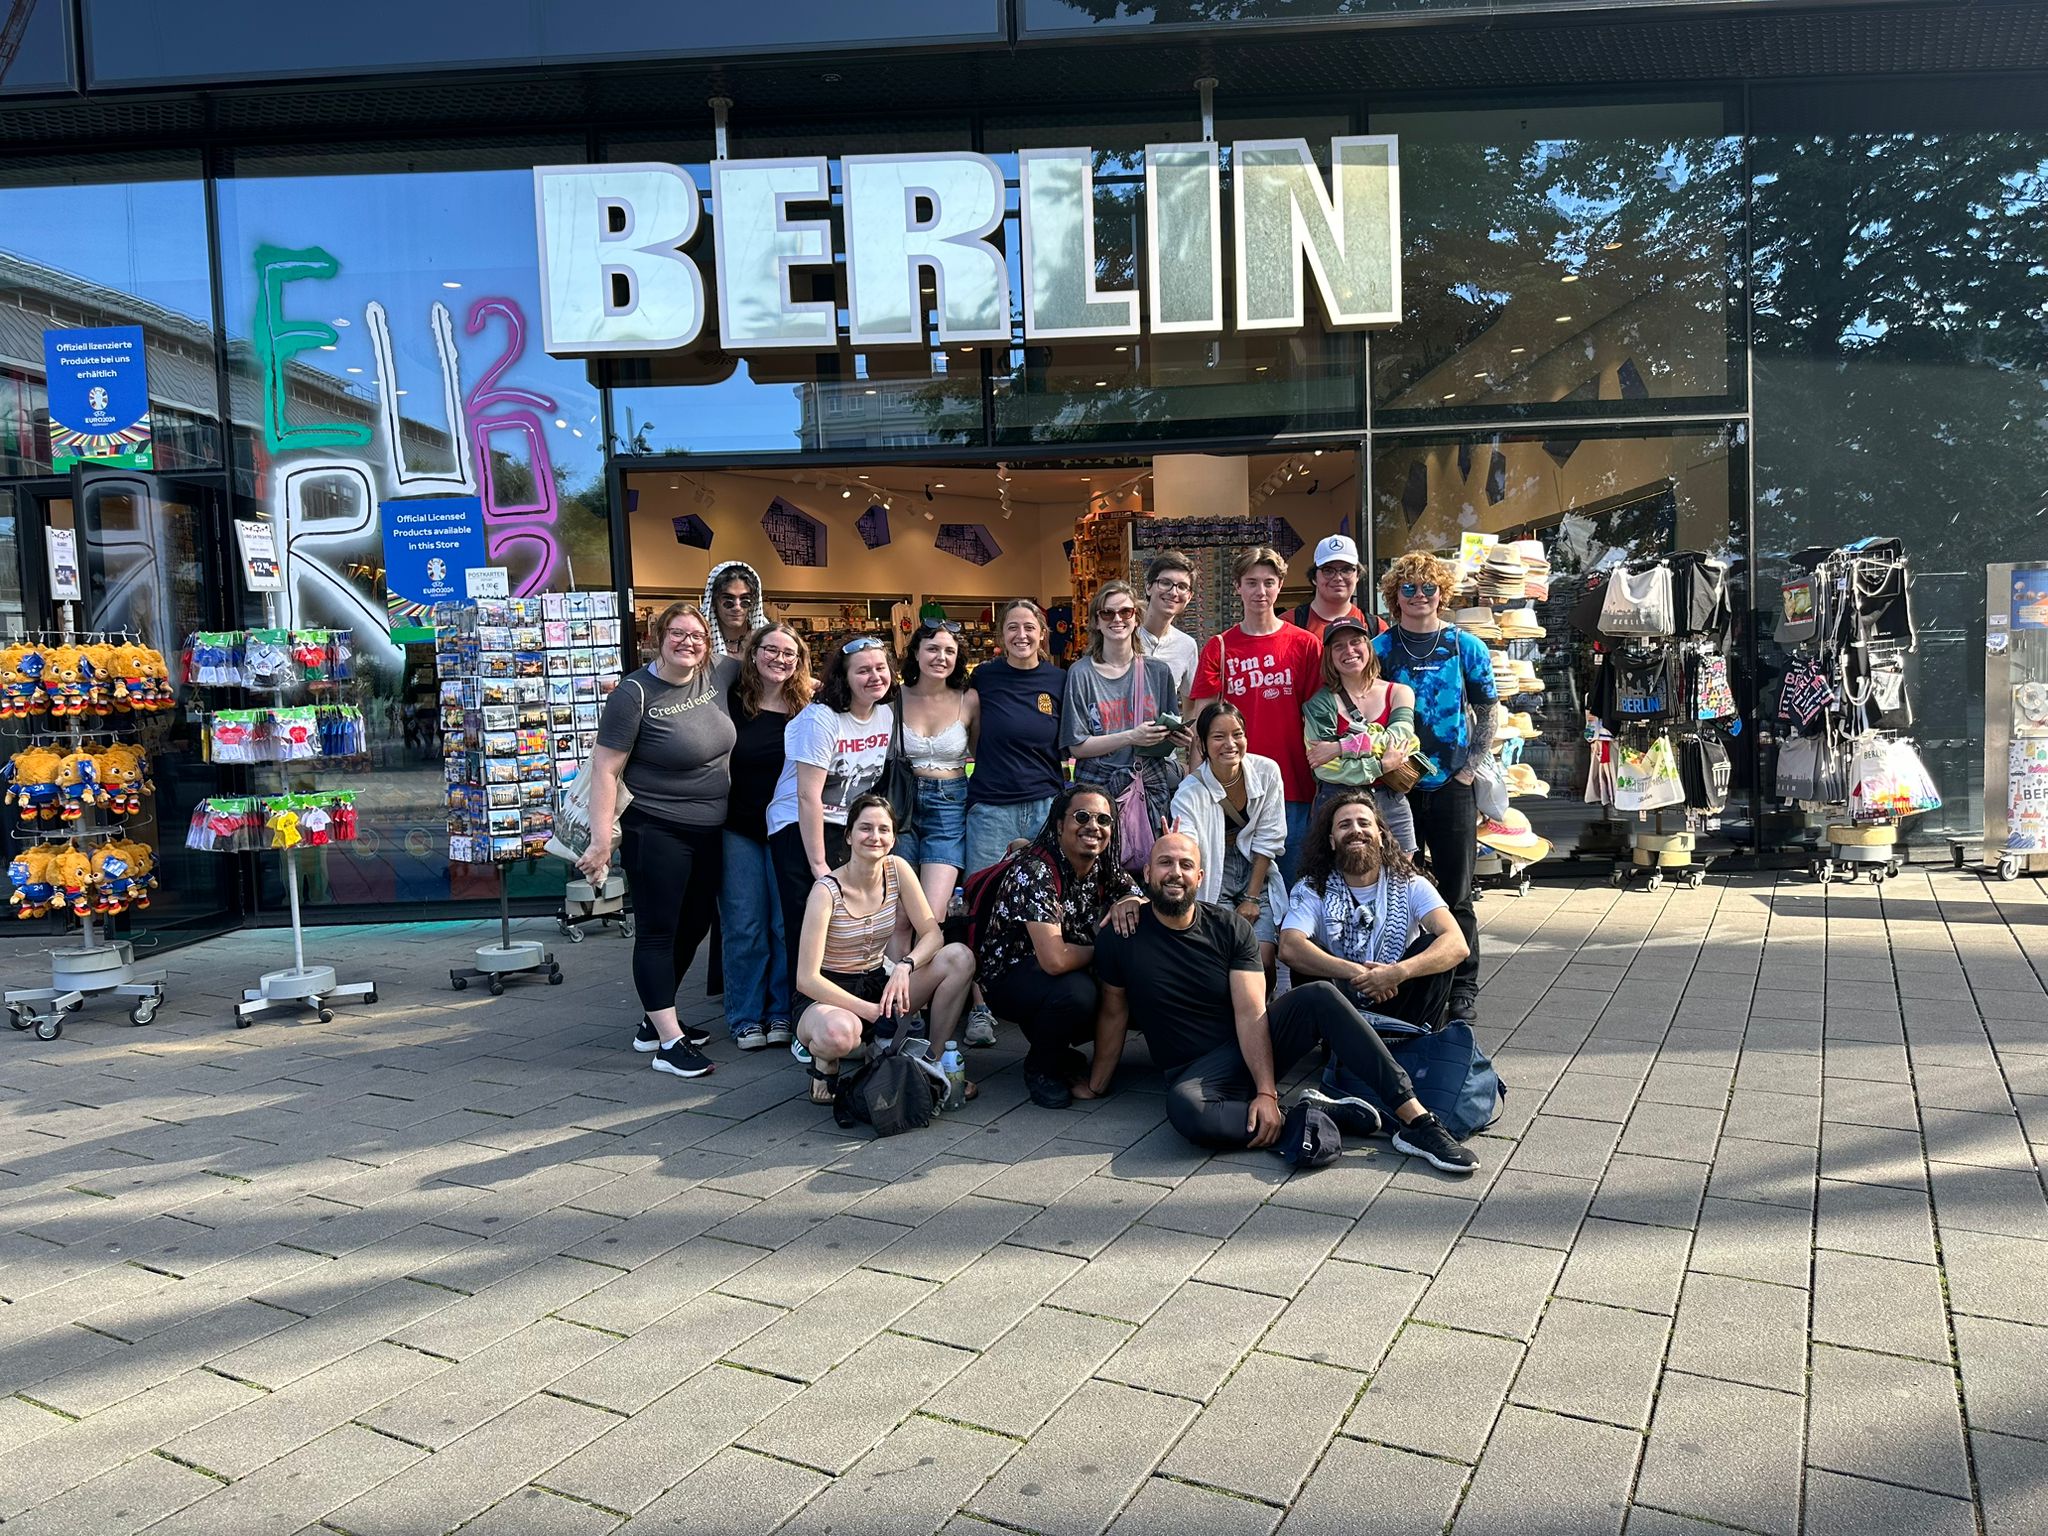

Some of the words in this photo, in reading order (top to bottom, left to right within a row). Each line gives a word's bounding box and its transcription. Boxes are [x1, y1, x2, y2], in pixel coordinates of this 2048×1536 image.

[534, 134, 1402, 356] BERLIN
[56, 342, 88, 352] Offiziell
[88, 341, 133, 350] lizenzierte
[60, 357, 100, 366] Produkte
[100, 355, 114, 364] bei
[114, 356, 130, 364] uns
[77, 369, 117, 379] erhältlich
[396, 513, 428, 523] Official
[427, 512, 466, 522] Licensed
[393, 528, 433, 537] Products
[433, 526, 472, 535] available
[408, 542, 417, 550] in
[417, 541, 435, 550] this
[435, 540, 460, 549] Store
[1226, 656, 1259, 676] I'm
[1263, 654, 1276, 668] a
[1248, 668, 1293, 689] Deal
[648, 698, 694, 718] Created
[694, 685, 719, 705] equal.
[1622, 697, 1661, 714] BERLIN
[837, 738, 864, 753] THE
[1863, 749, 1888, 760] BERLIN
[34, 784, 45, 792] 24
